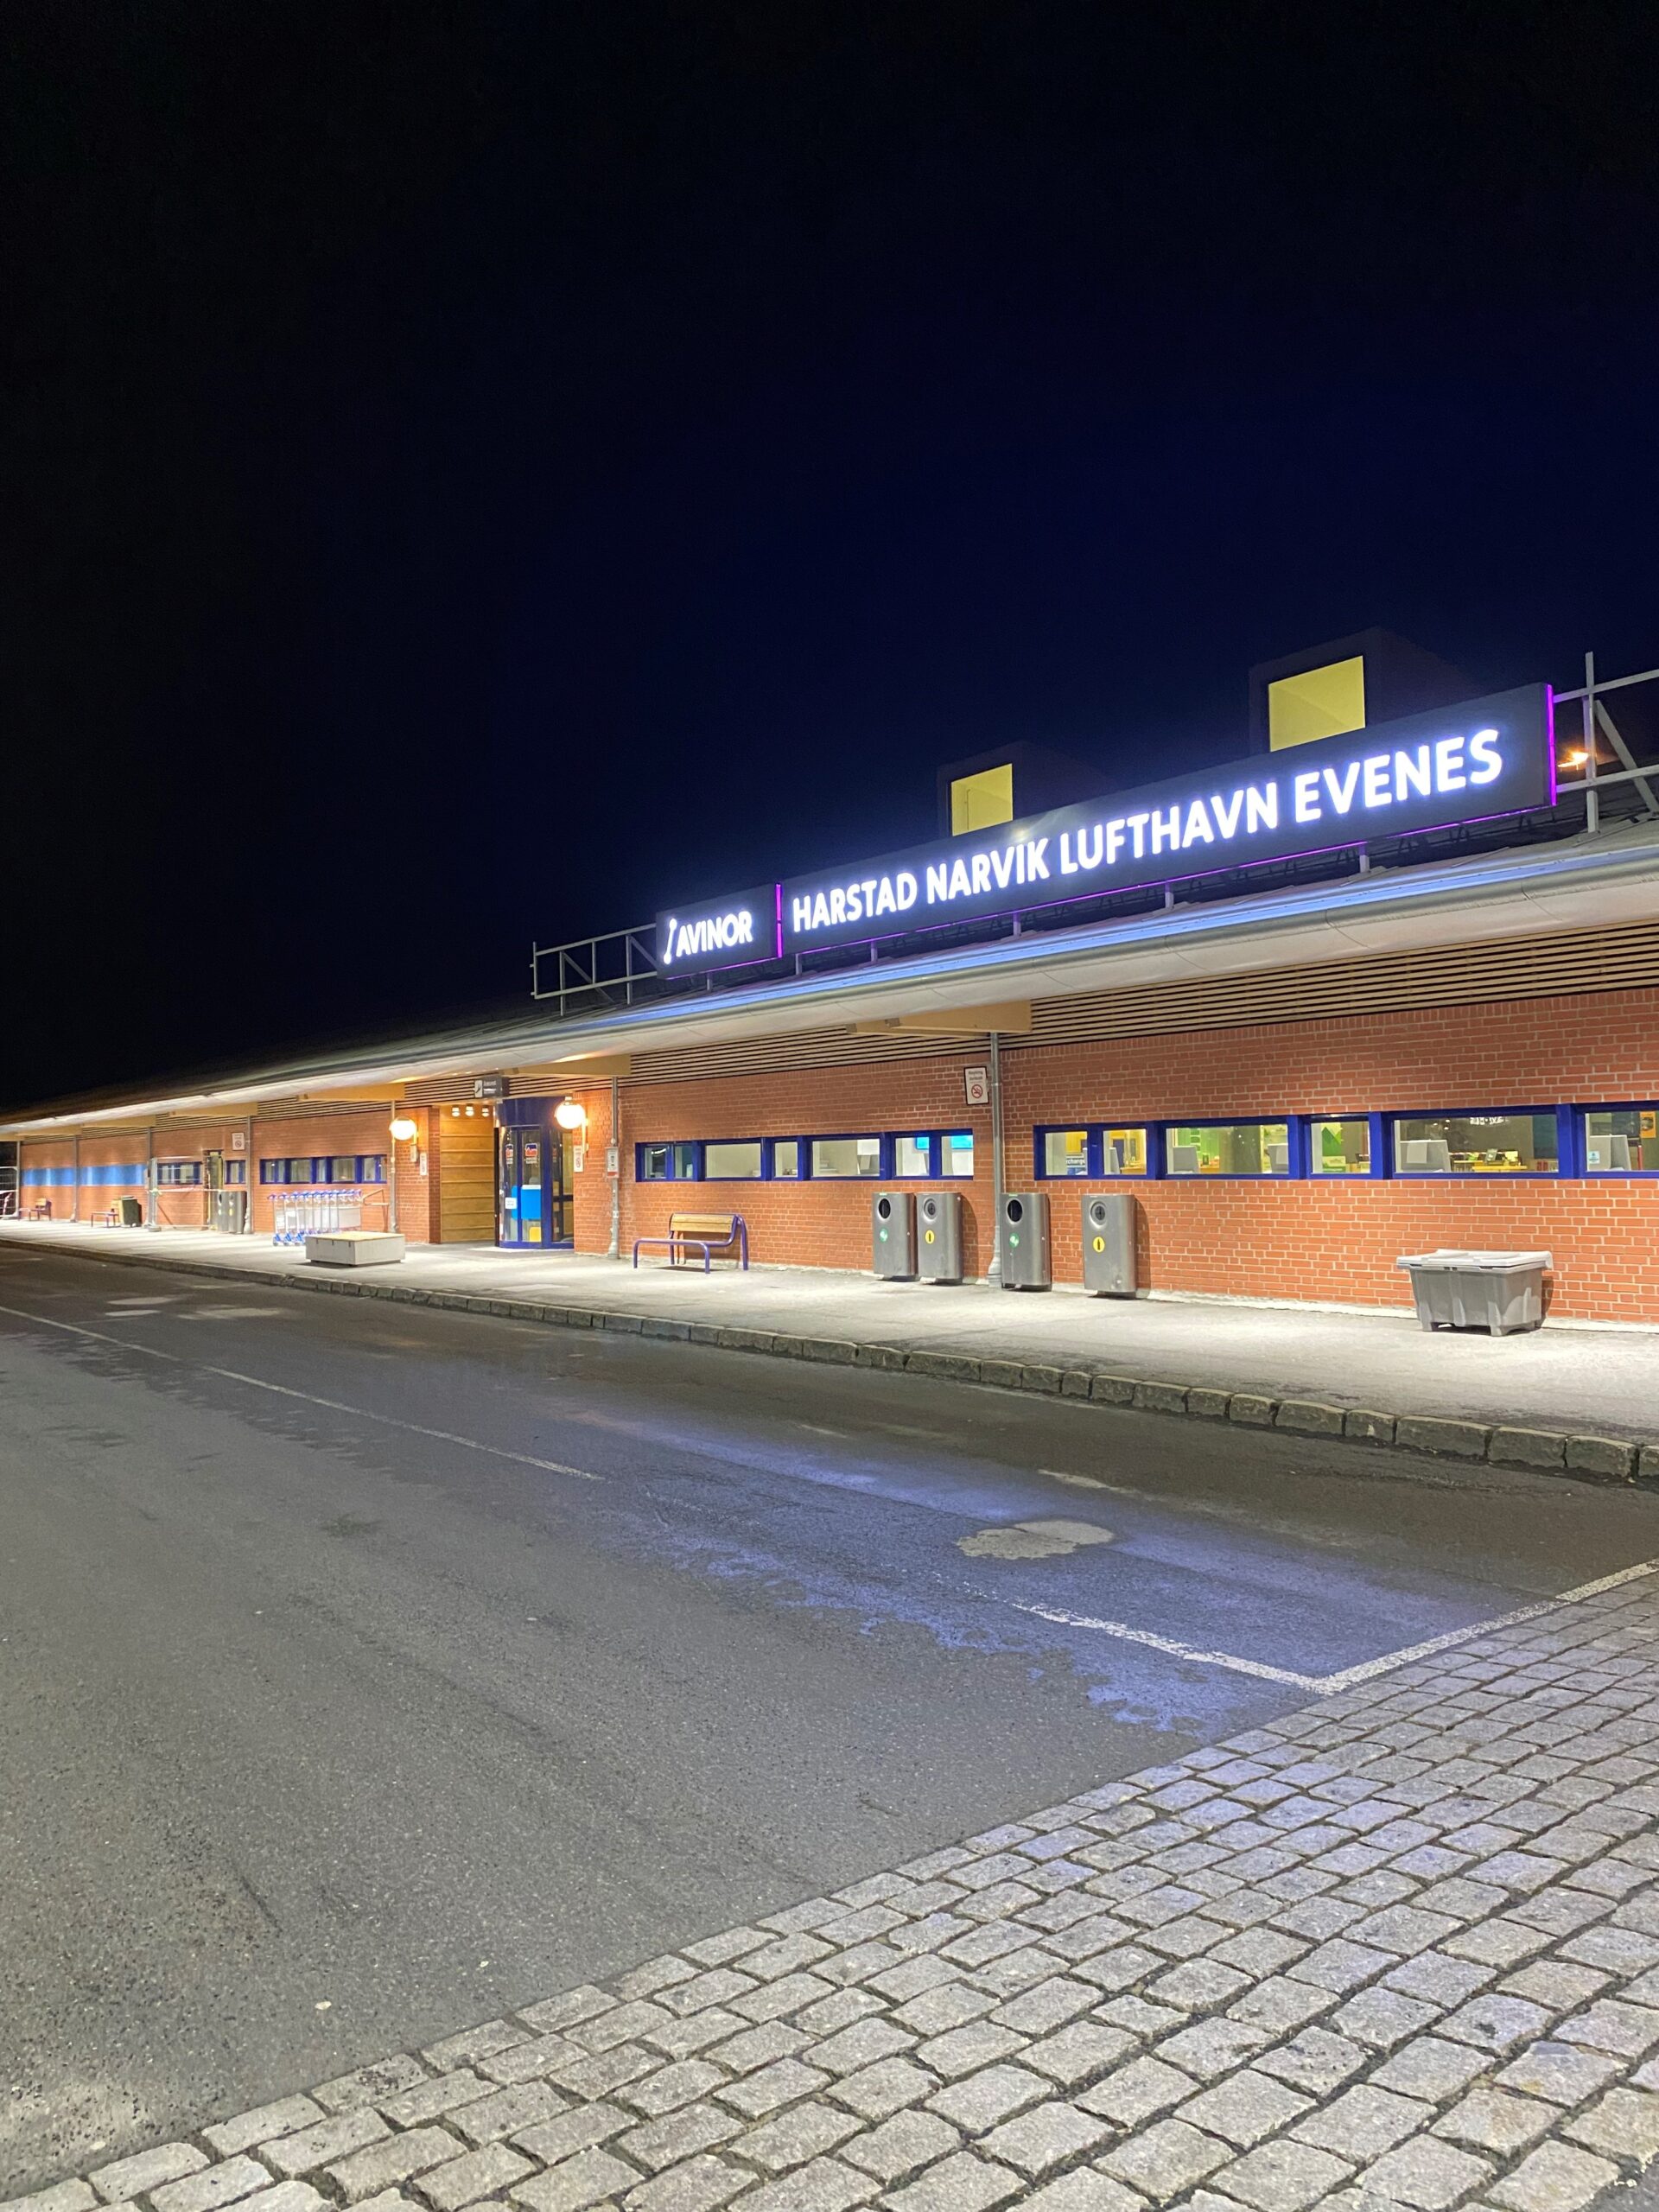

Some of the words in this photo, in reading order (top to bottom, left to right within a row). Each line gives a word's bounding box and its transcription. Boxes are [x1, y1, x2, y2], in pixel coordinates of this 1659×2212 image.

[792, 872, 918, 932] HARSTAD
[926, 837, 1051, 905] NARVIK
[1058, 782, 1278, 875] LUFTHAVN
[1294, 728, 1503, 823] EVENES
[676, 911, 753, 957] AVINOR
